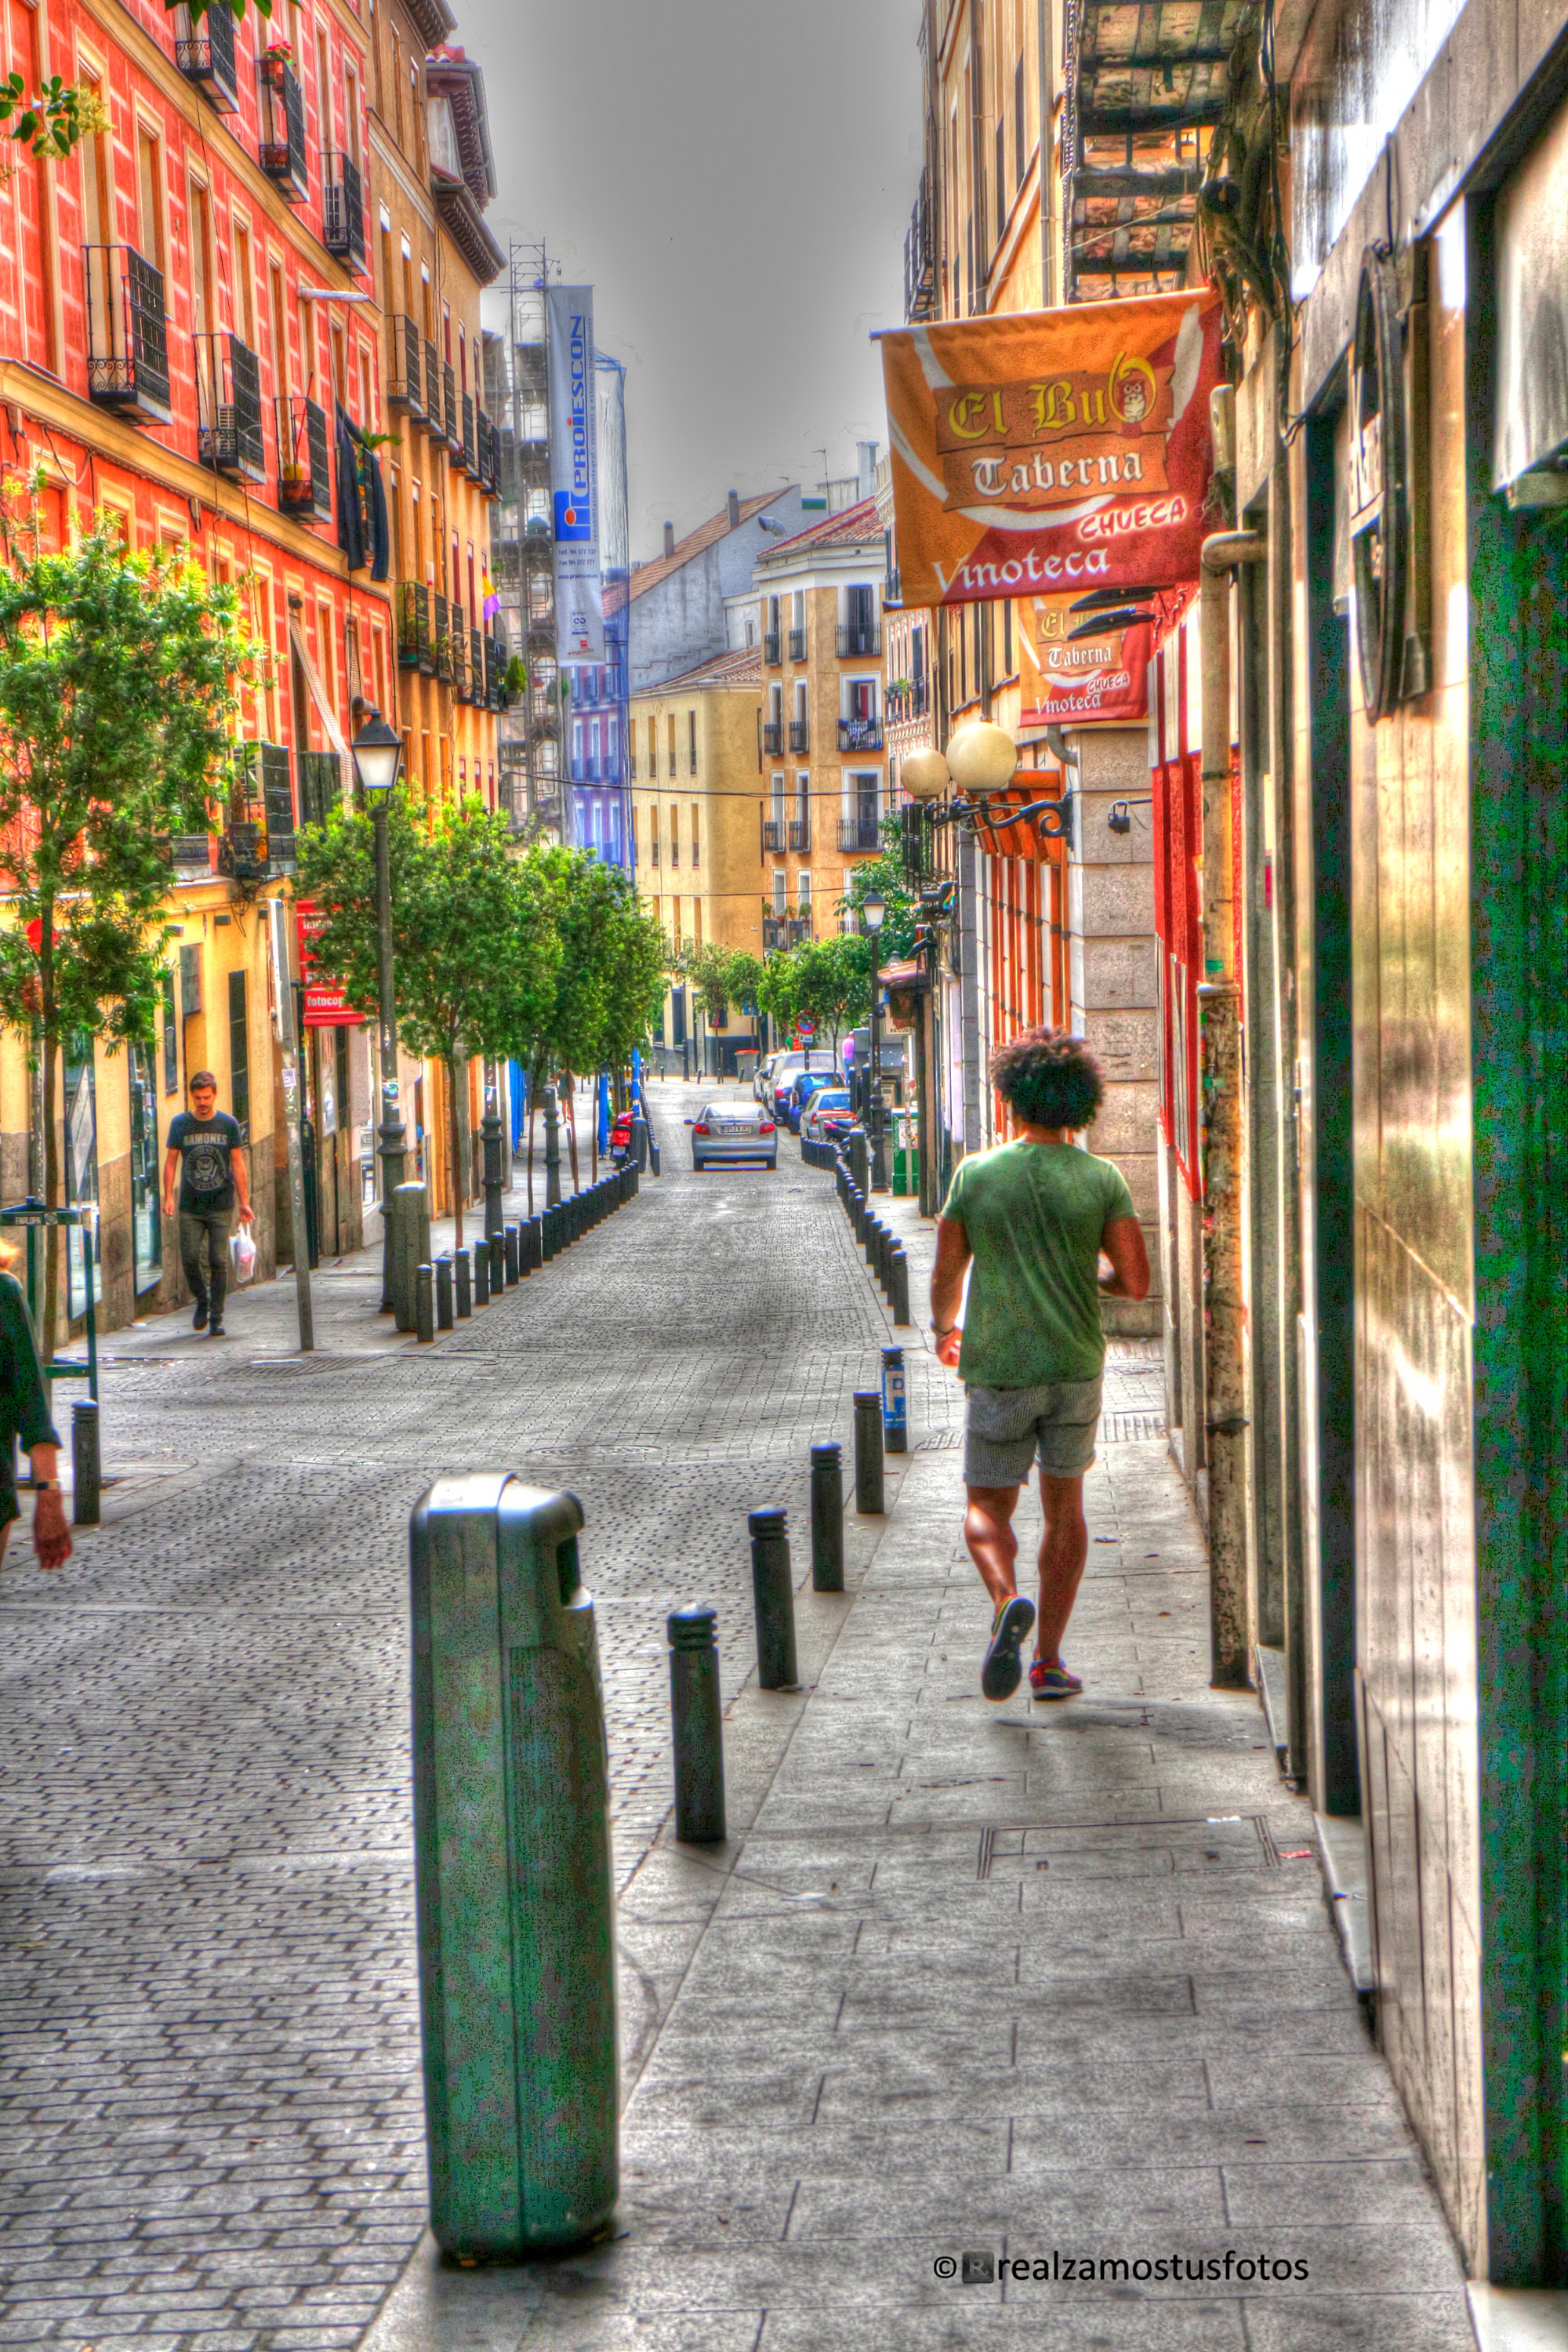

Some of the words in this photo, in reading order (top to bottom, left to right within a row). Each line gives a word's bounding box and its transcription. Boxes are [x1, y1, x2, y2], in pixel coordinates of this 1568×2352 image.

[948, 390, 1011, 439] El
[970, 451, 1145, 497] Taberna
[1079, 495, 1186, 540] CHUECA
[931, 548, 1111, 593] Vinoteca
[1041, 612, 1065, 637] El
[1048, 646, 1112, 668] Taberna
[1087, 672, 1130, 694] CHUECA
[1036, 693, 1102, 715] Vinoteca
